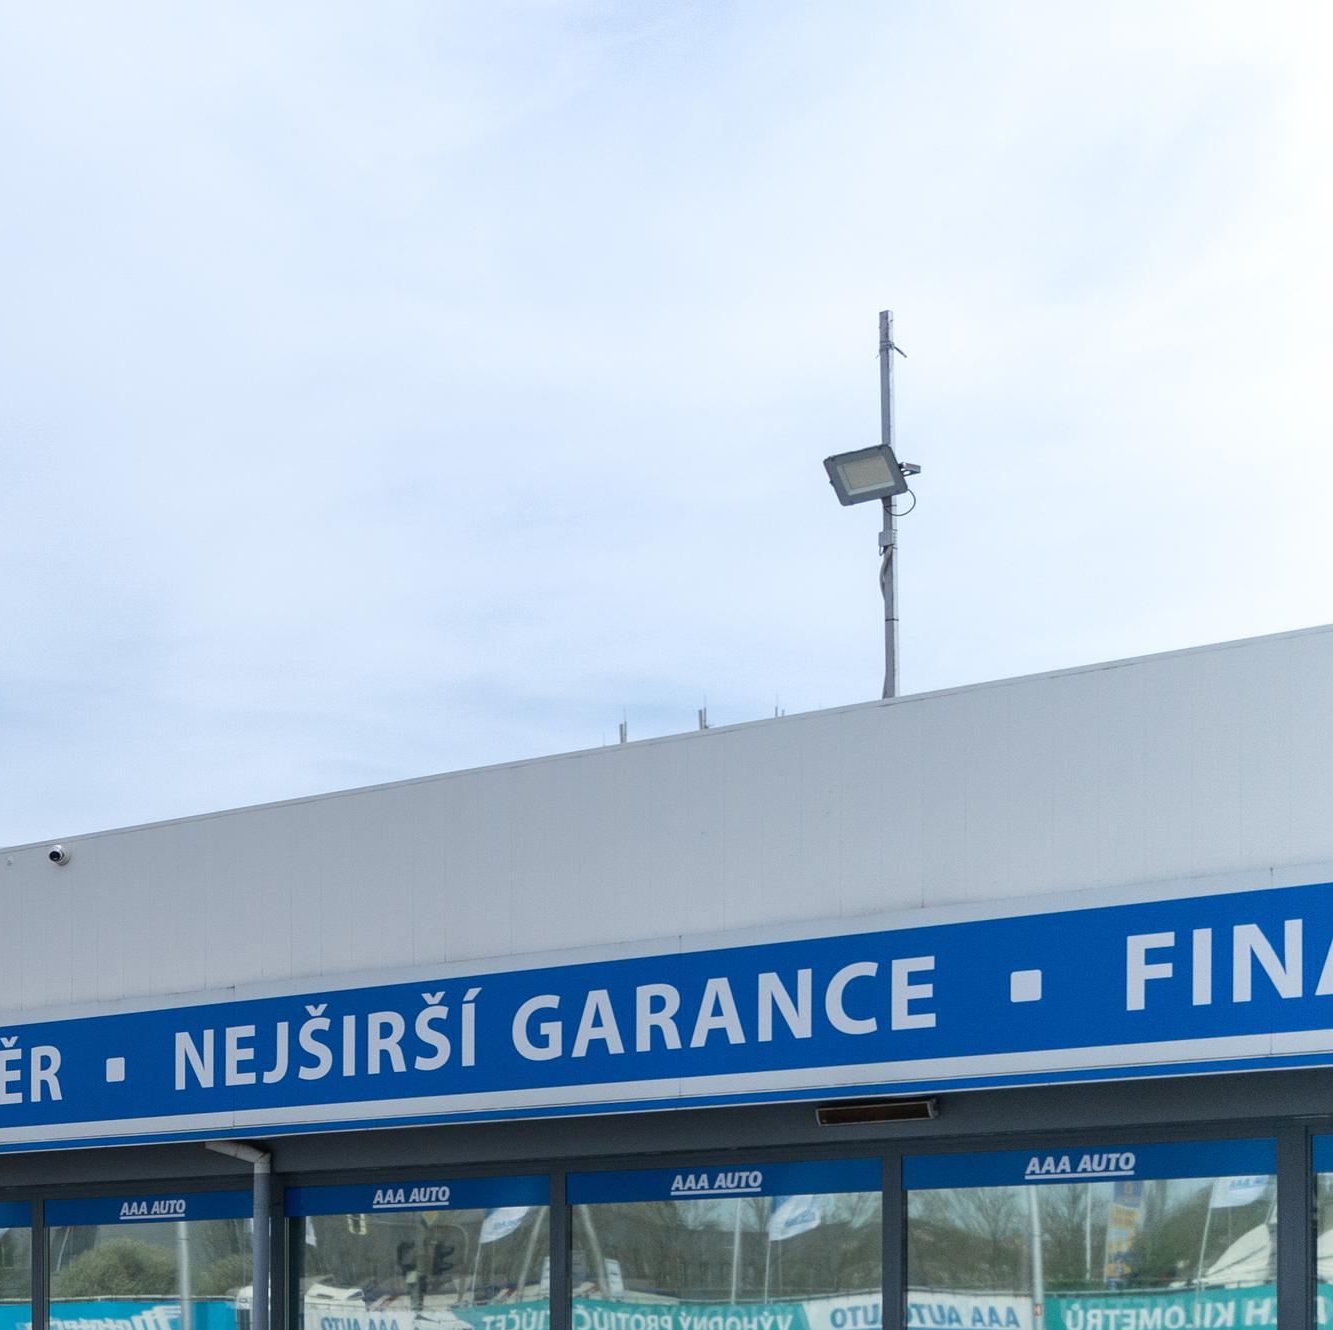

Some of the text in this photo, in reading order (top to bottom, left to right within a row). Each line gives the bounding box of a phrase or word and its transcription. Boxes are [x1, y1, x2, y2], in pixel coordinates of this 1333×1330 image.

[1126, 916, 1333, 1011] FIN
[175, 956, 937, 1091] NEJŠIRŠÍ GARANCE
[1026, 1153, 1136, 1174] AAA AUTO
[671, 1171, 763, 1190] AAA AUTO
[373, 1186, 450, 1204] AAA AUTO
[120, 1199, 186, 1216] AAA AUTO
